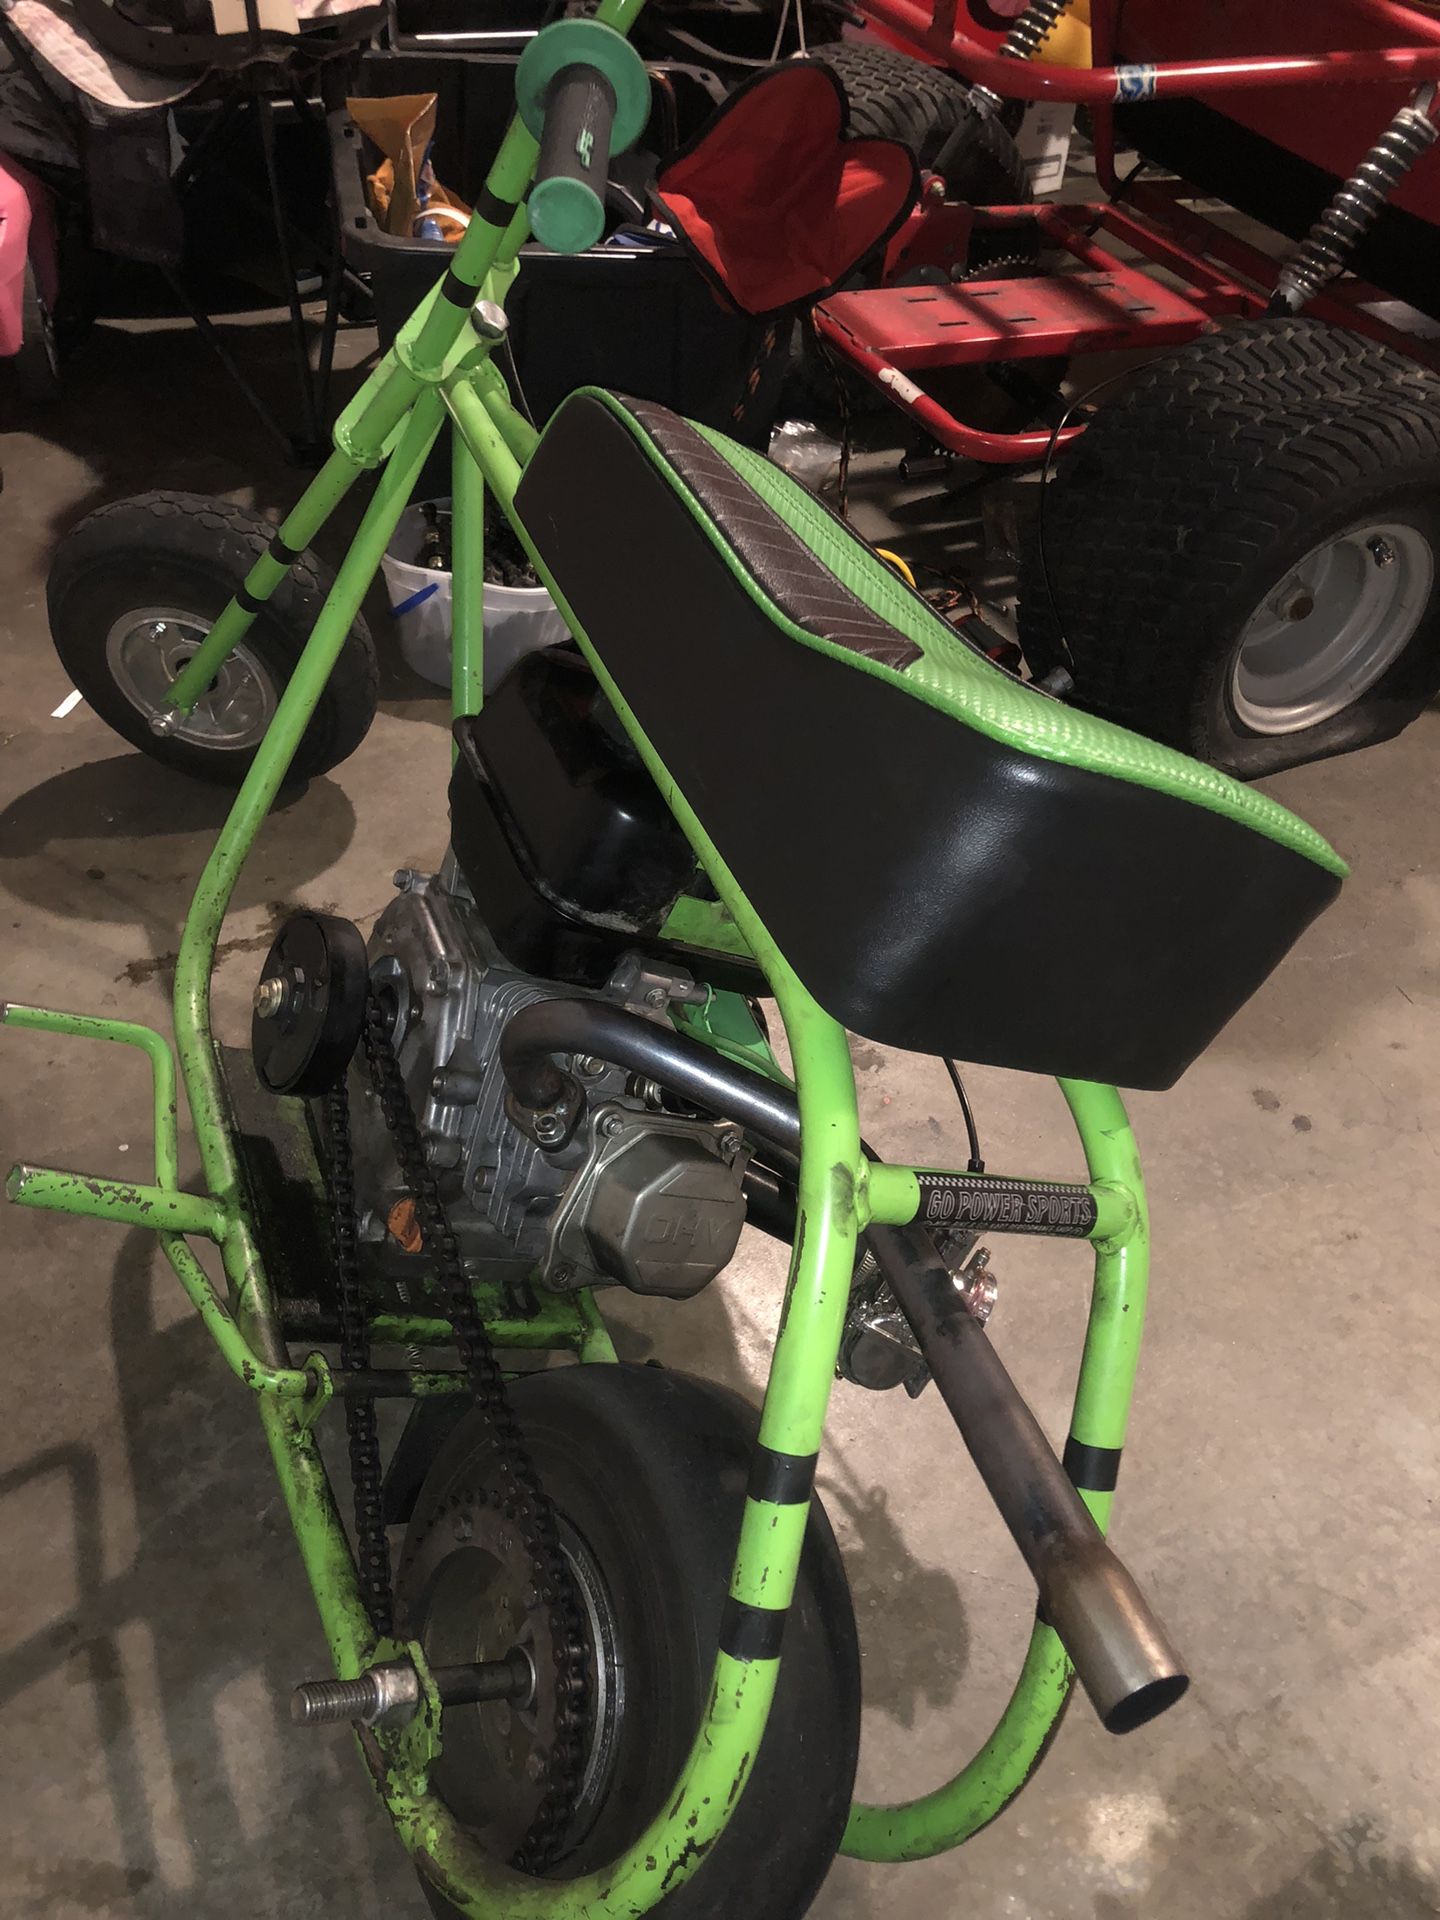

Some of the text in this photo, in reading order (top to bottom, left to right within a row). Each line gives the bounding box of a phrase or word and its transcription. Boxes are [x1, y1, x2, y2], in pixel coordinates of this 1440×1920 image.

[926, 1189, 1092, 1226] GO POWER SPORTS
